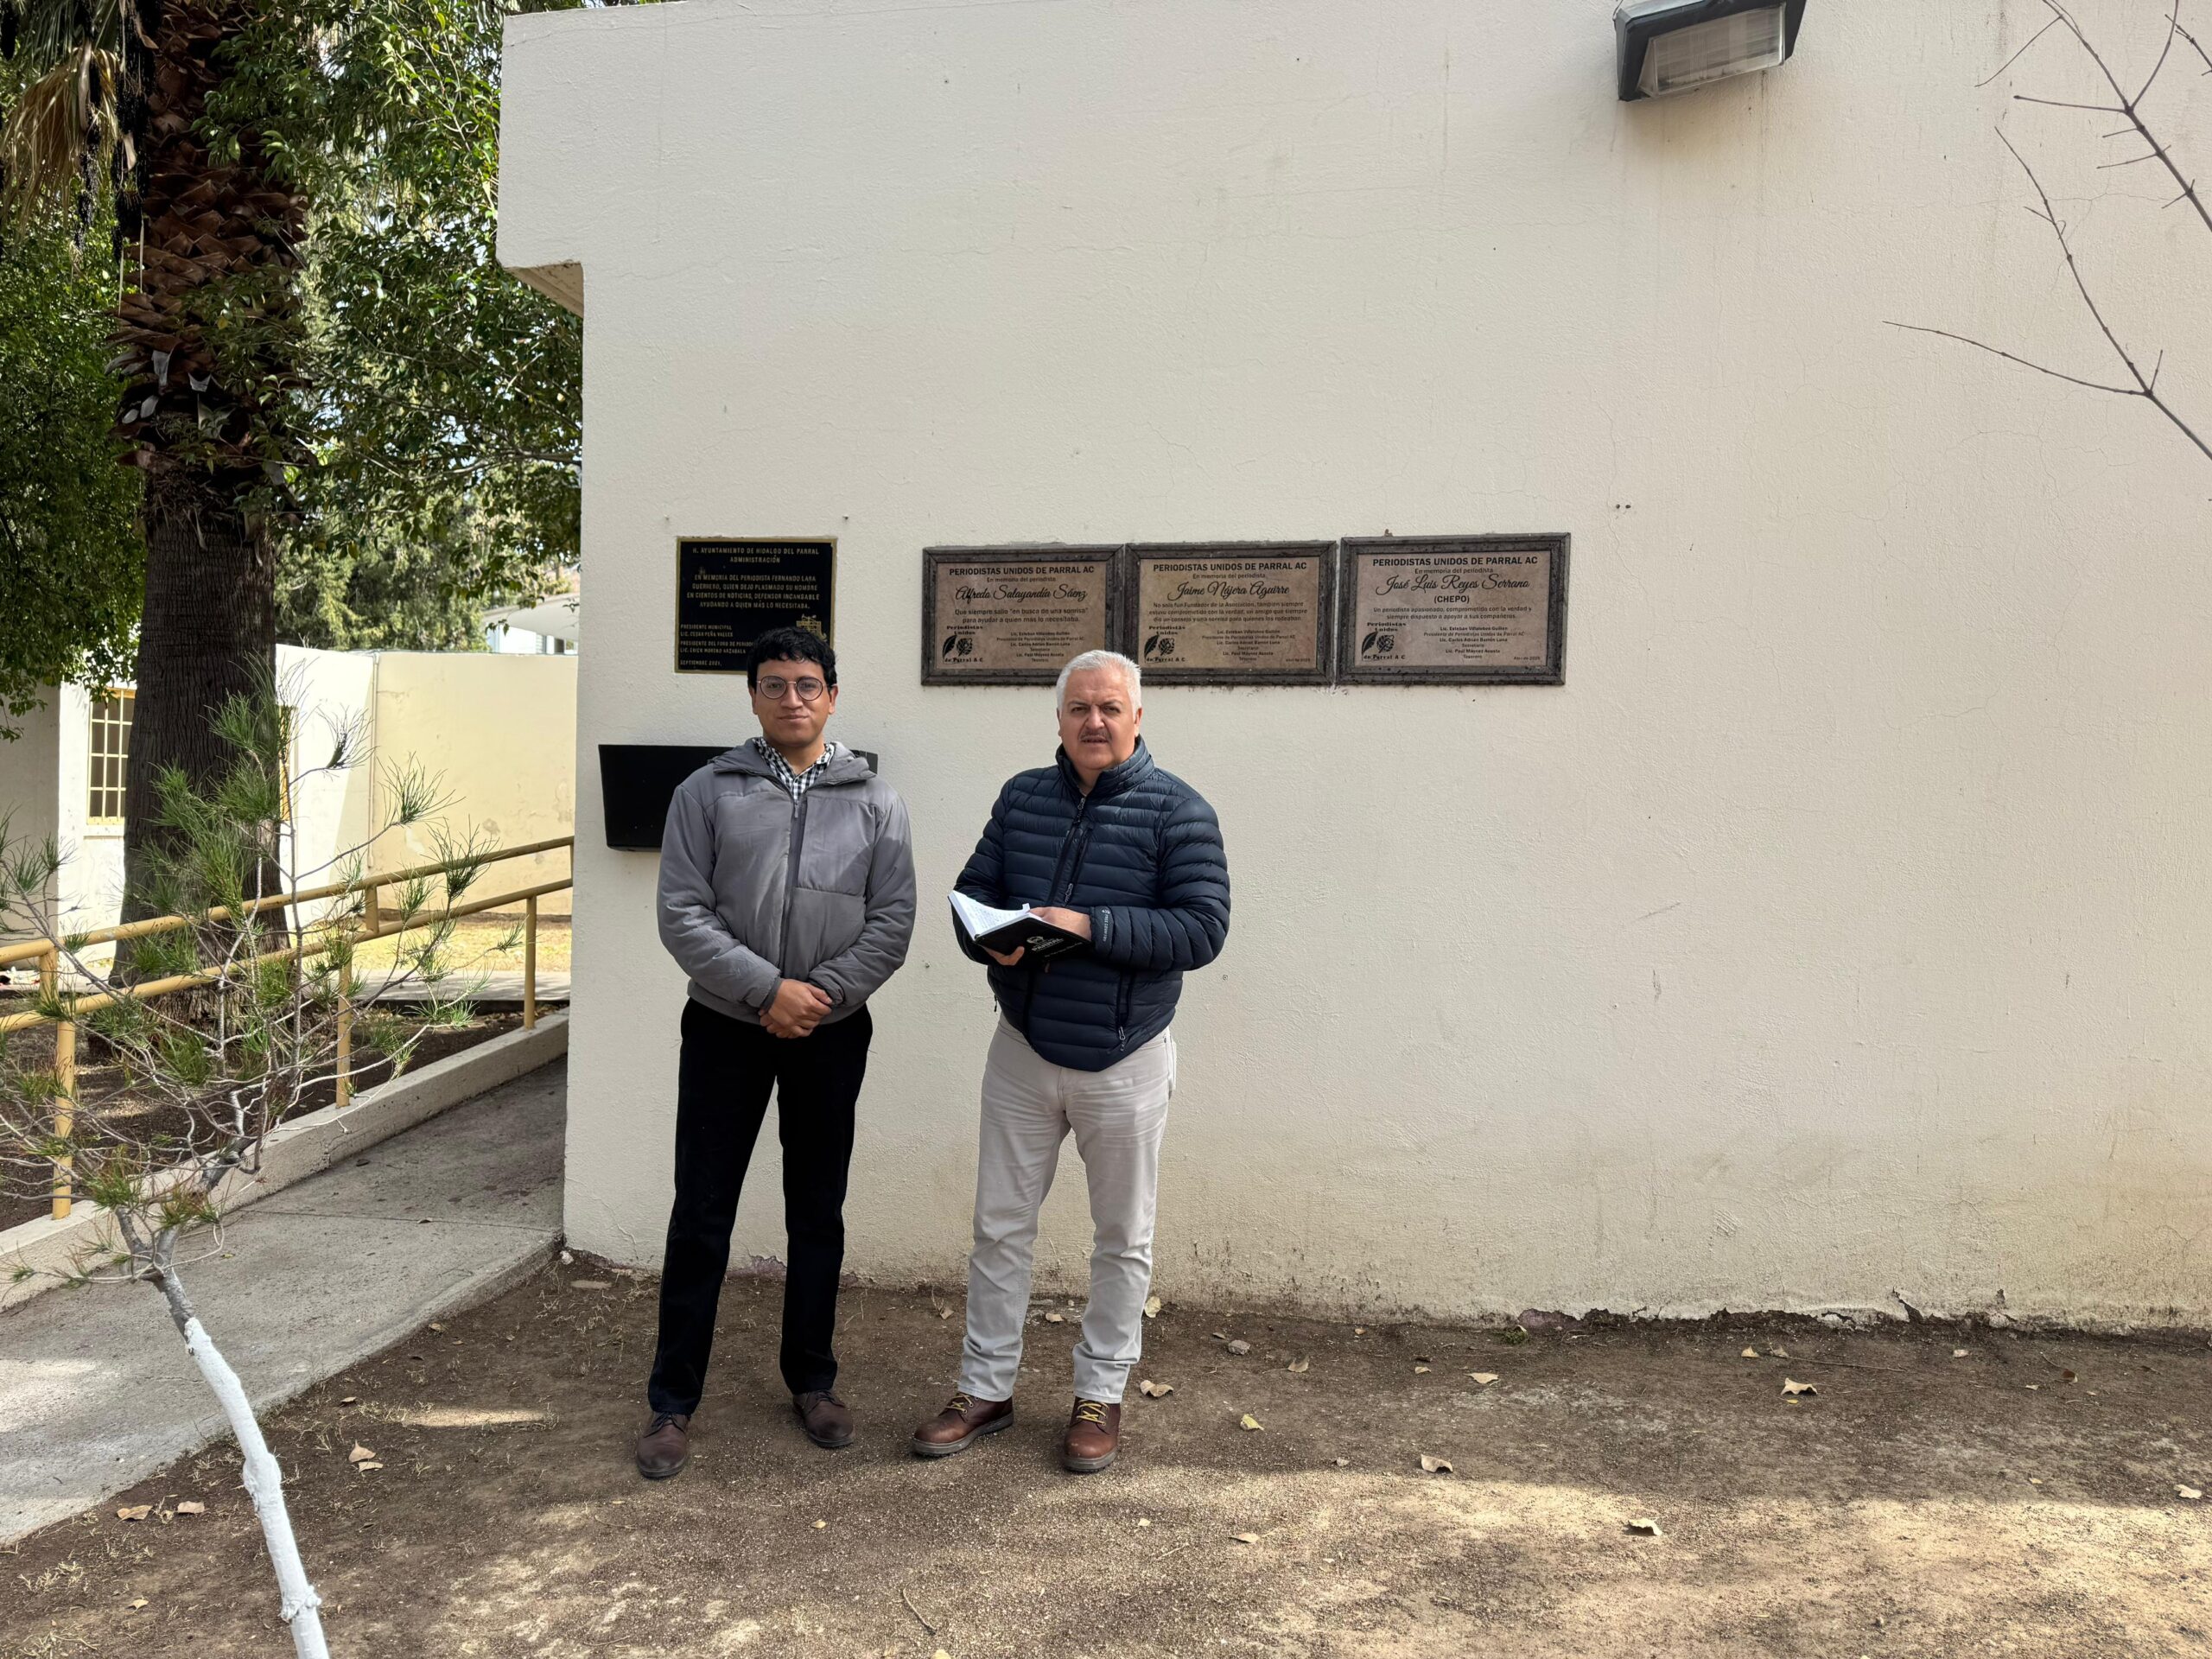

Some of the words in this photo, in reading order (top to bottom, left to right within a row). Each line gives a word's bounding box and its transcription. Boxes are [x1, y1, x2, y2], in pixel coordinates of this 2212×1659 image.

[730, 555, 780, 563] ADMINISTRACIÓN
[955, 586, 990, 604] Alfredo
[994, 584, 1051, 603] Salayandía
[1053, 583, 1088, 602] Sáenz
[1167, 582, 1205, 601] Jaime
[1207, 581, 1248, 599] Nájera
[1250, 581, 1290, 599] Aguirre
[1376, 575, 1410, 595] José
[1411, 574, 1439, 594] Luis
[1440, 575, 1480, 594] Reyes
[1482, 574, 1530, 590] Serrano
[1434, 595, 1470, 604] (CHEPO)
